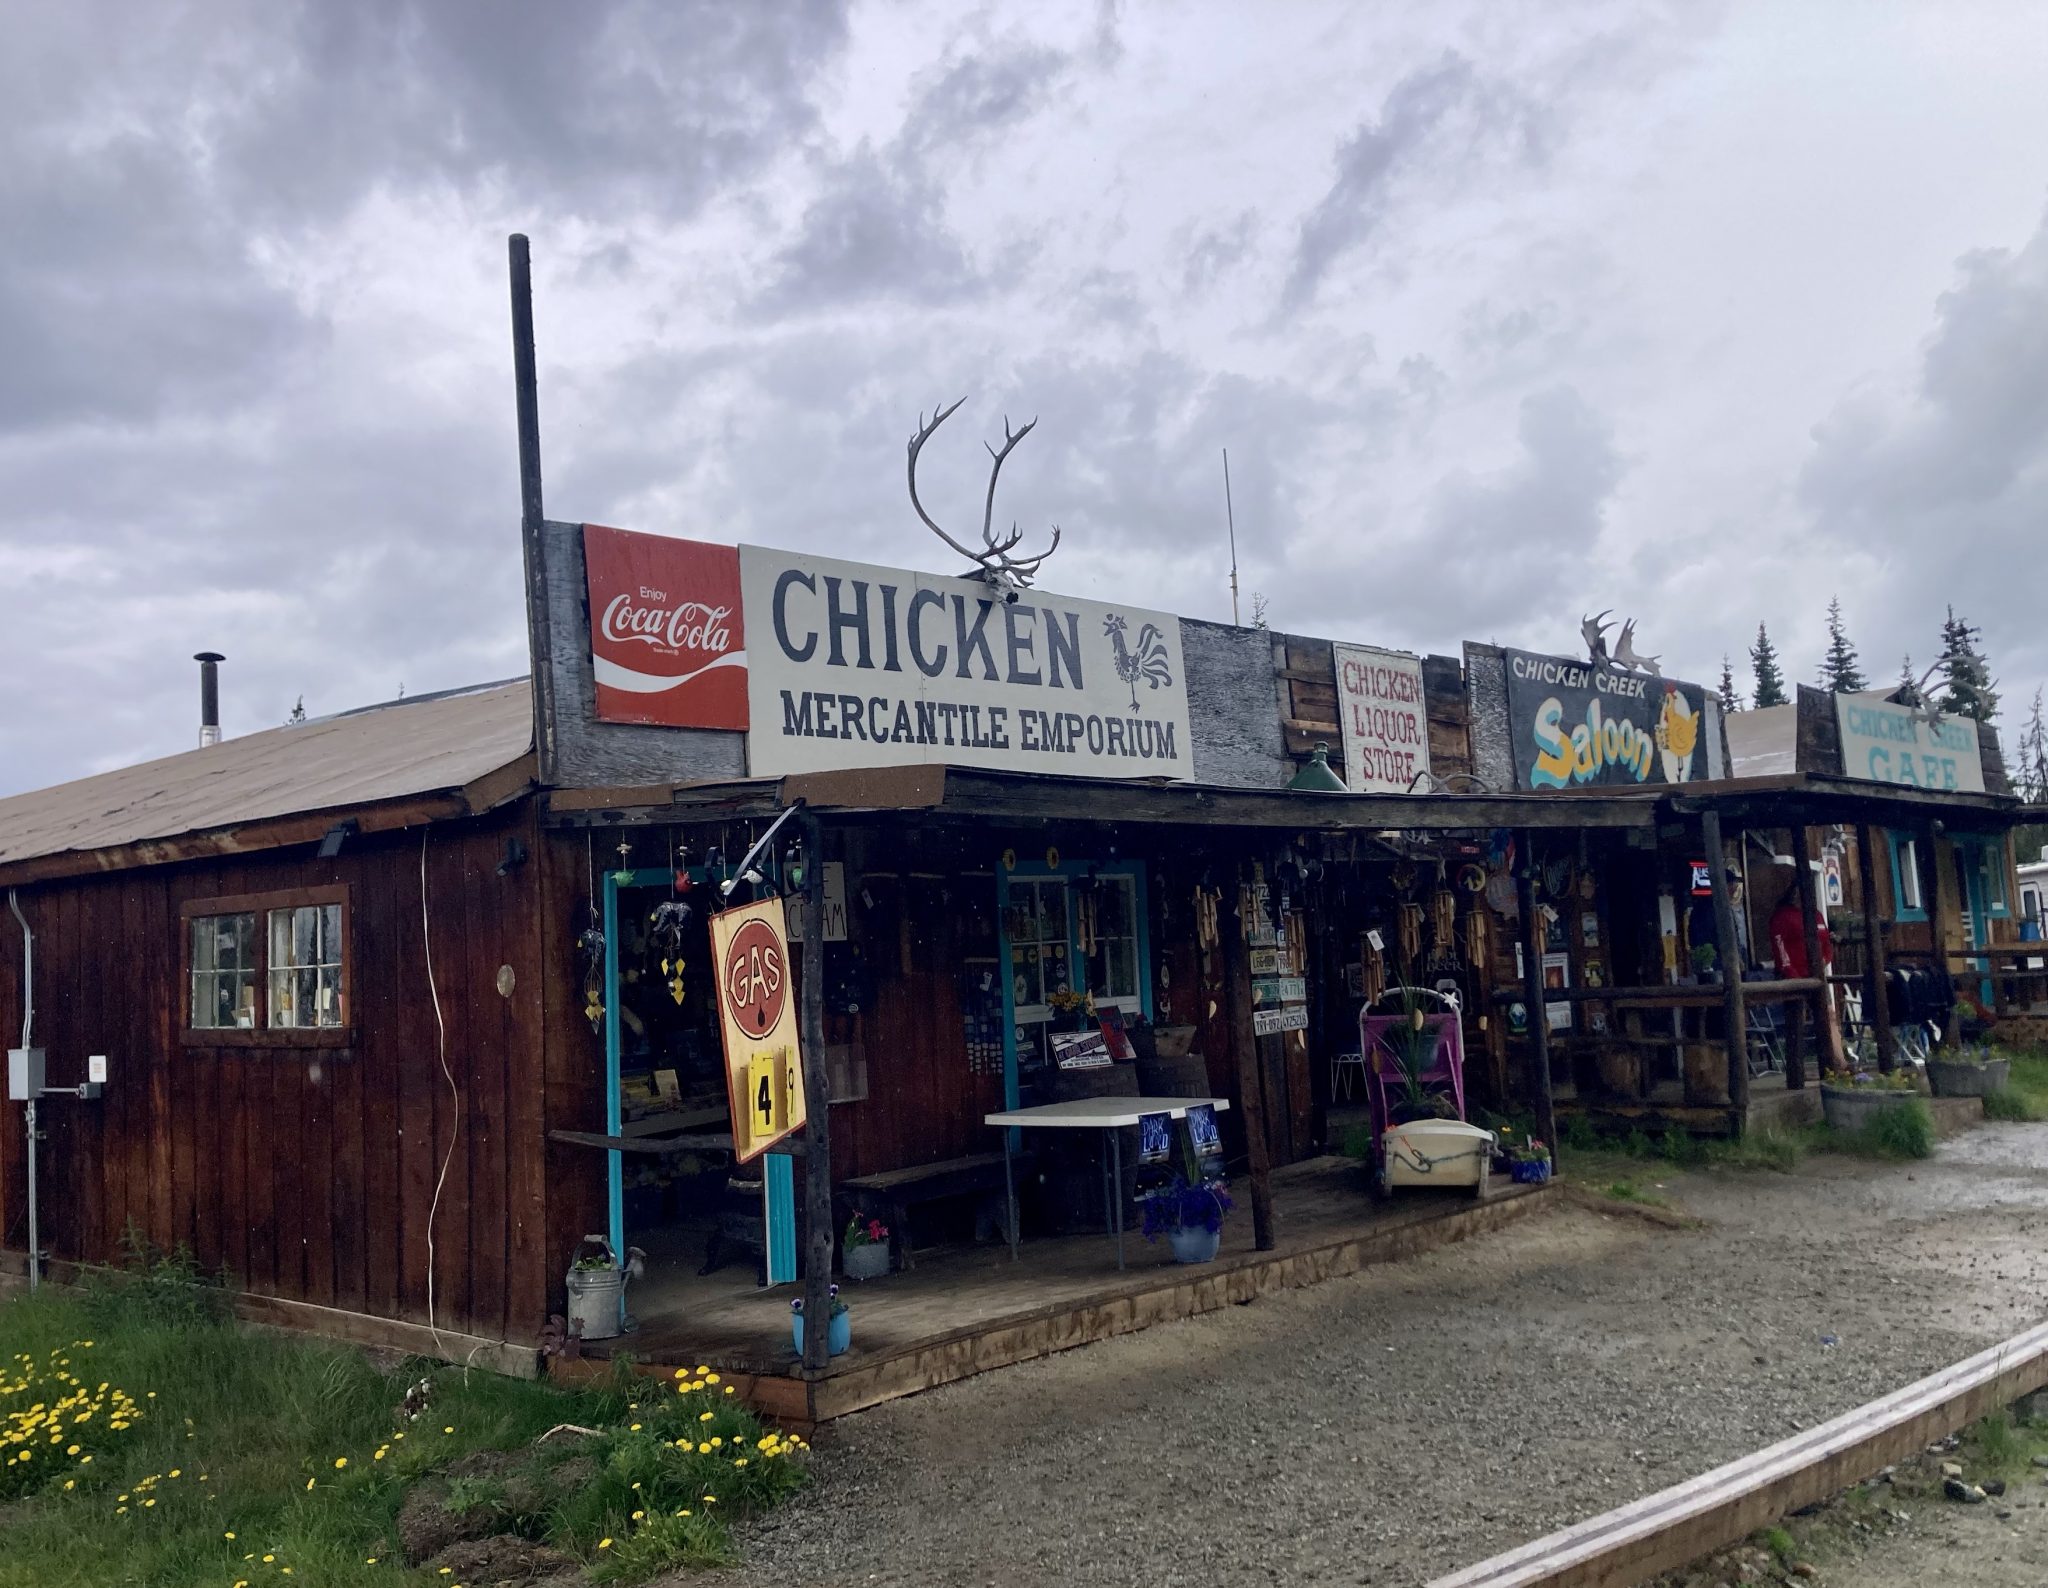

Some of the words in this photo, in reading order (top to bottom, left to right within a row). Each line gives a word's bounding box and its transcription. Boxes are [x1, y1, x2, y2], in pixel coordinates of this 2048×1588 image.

[640, 585, 667, 602] Enjoy
[601, 593, 733, 652] Coca-Cola
[772, 569, 1084, 690] CHICKEN
[1343, 660, 1420, 703] CHICKEN
[1512, 656, 1590, 688] CHICKEN
[1595, 671, 1647, 699] CREEK
[780, 689, 1010, 750] MERCANTILE
[1018, 708, 1178, 760] EMPORIUM
[1353, 703, 1421, 748] LIQUOR
[1531, 697, 1653, 789] Saloon
[1847, 705, 1918, 744] CHICKEN
[1363, 746, 1415, 785] STORE
[1868, 745, 1959, 791] CAFE
[788, 903, 847, 938] CAM
[730, 944, 780, 1009] GAS
[758, 1075, 772, 1126] 4
